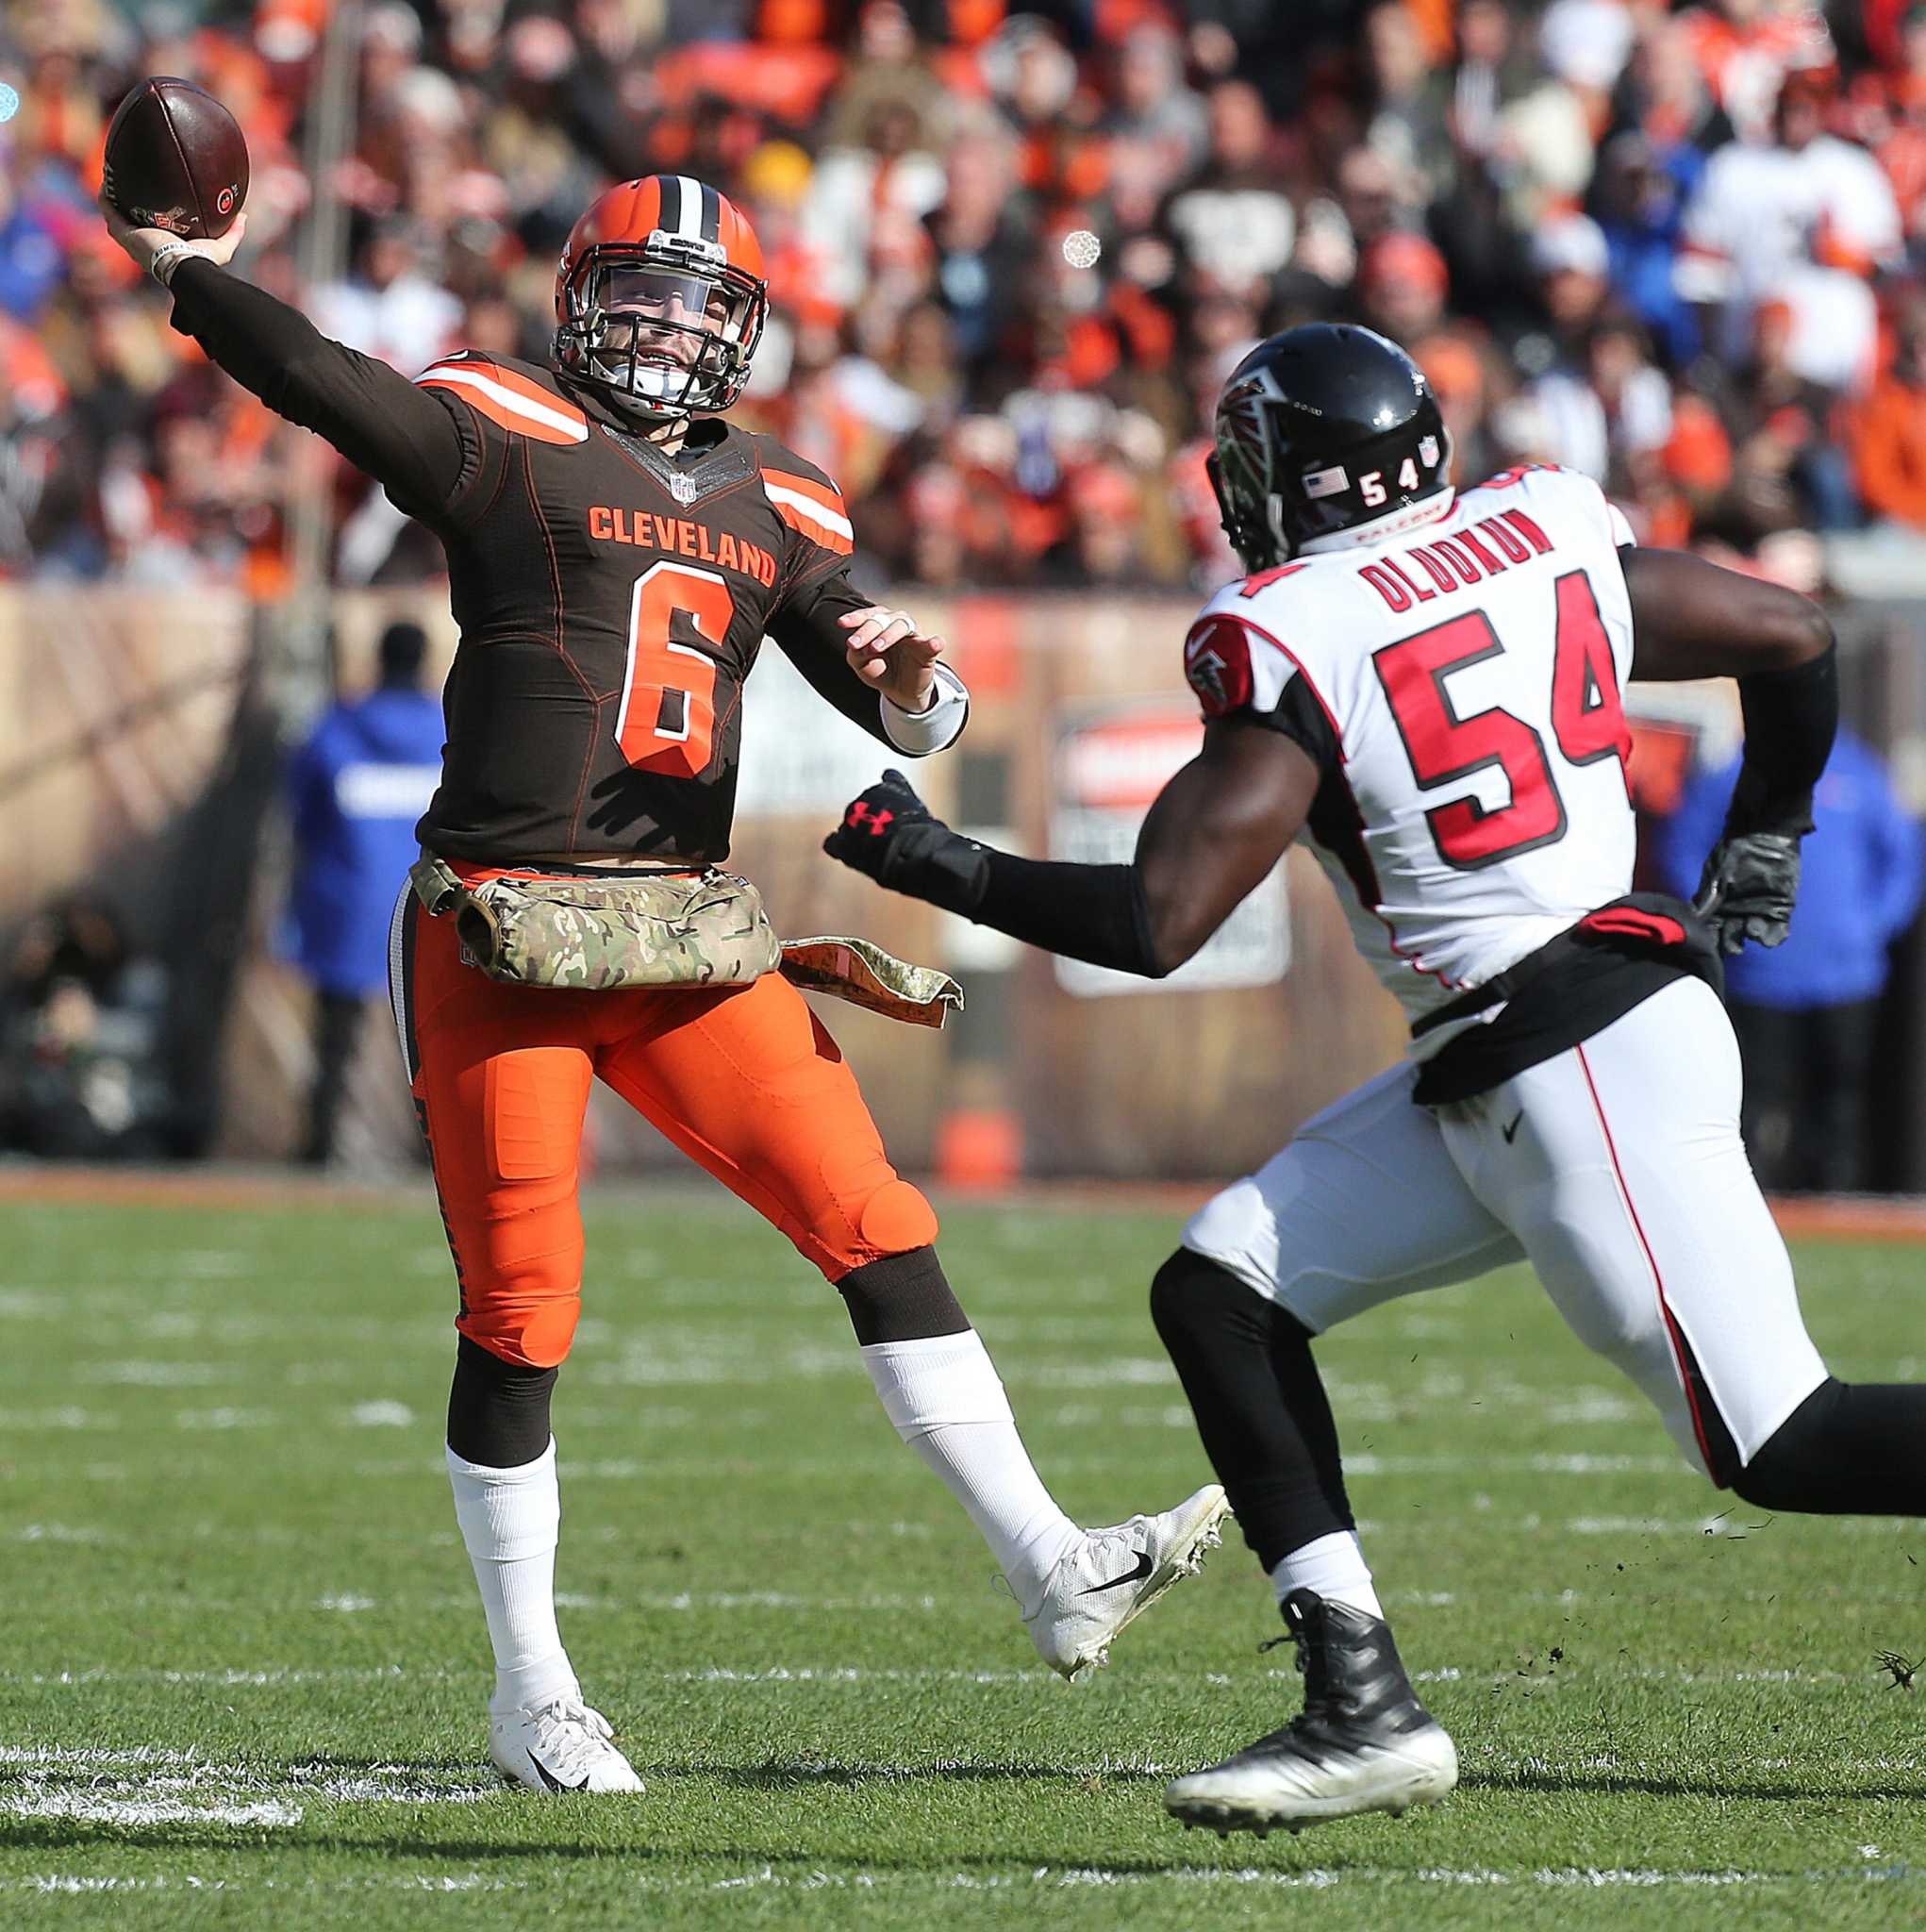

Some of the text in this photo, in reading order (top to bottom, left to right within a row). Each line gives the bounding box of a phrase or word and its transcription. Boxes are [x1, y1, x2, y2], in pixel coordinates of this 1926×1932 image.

[1358, 458, 1420, 507] 54
[589, 506, 778, 589] CLEVELAND
[1358, 508, 1554, 612] OLUOKUN
[614, 558, 735, 779] 6
[1371, 568, 1633, 872] 54
